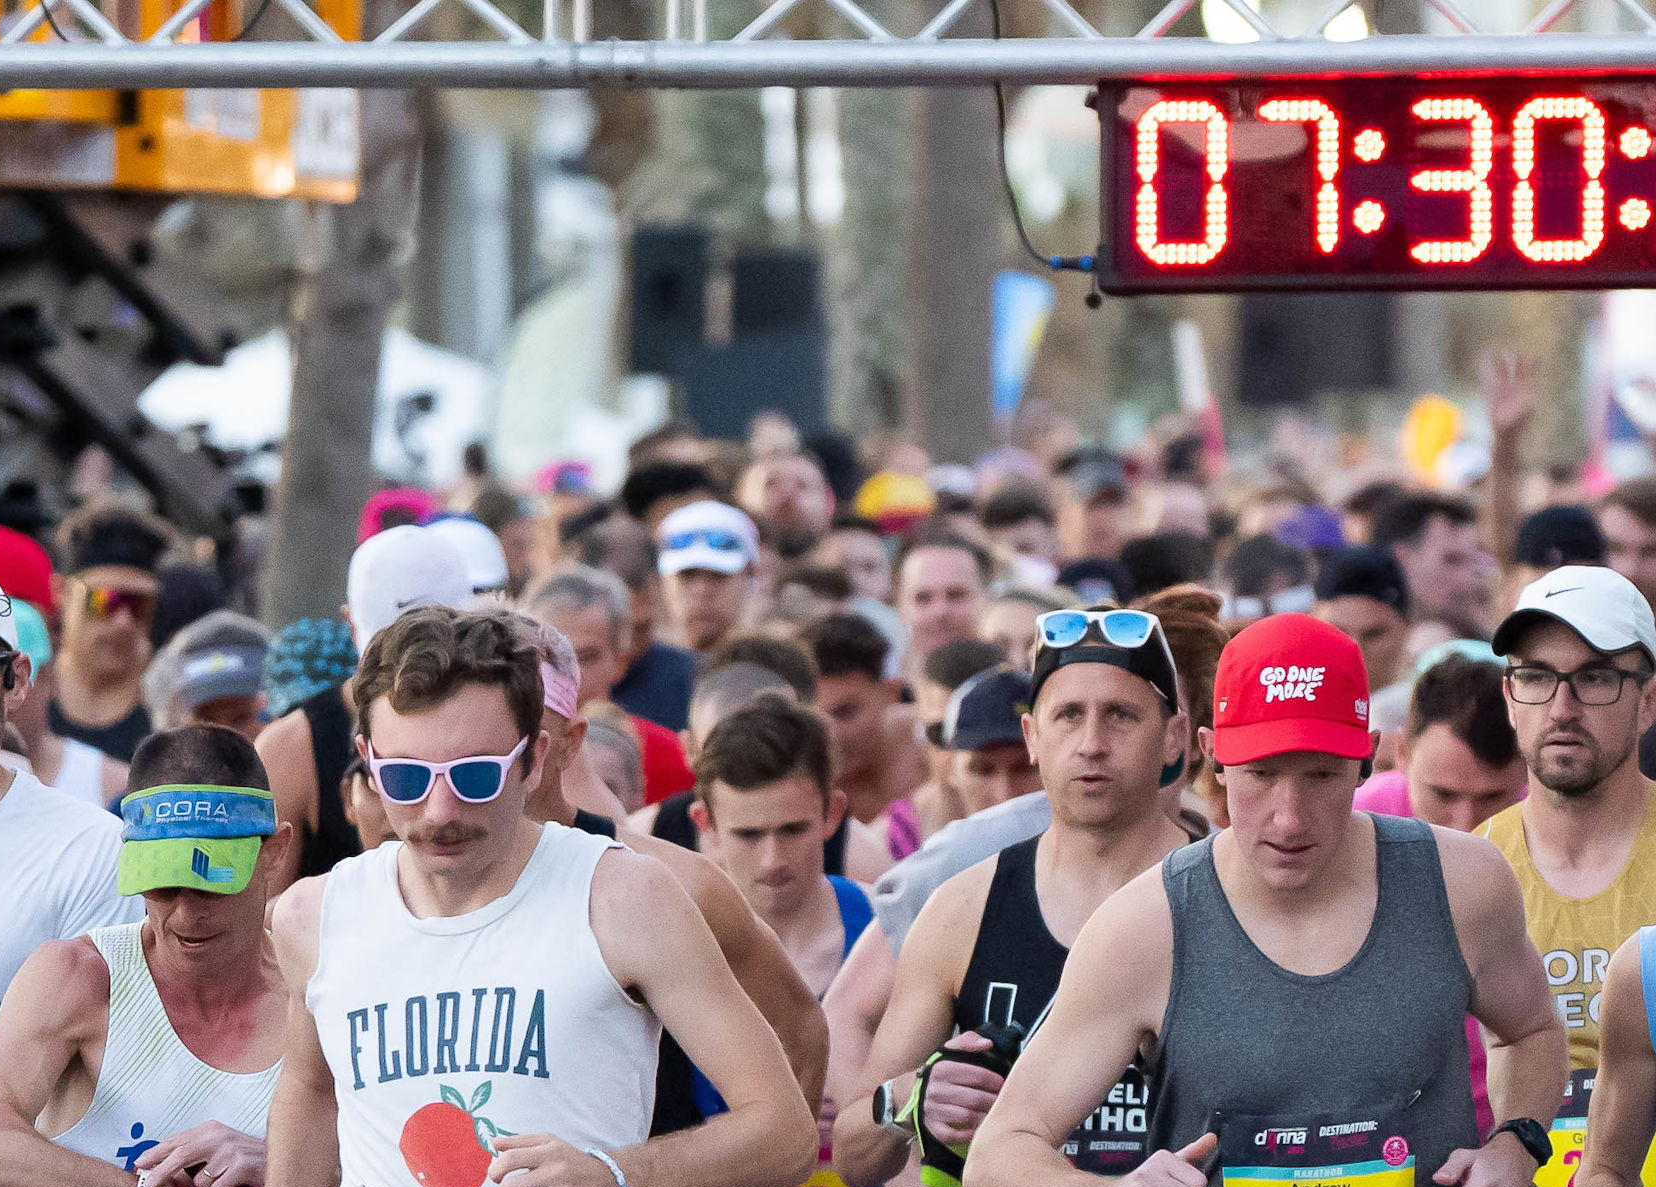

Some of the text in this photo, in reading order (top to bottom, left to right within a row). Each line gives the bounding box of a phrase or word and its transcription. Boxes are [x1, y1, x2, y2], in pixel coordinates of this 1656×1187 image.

[1259, 665, 1326, 685] GO ONE
[1266, 682, 1320, 703] MORE
[156, 801, 229, 817] CORA
[156, 815, 191, 824] Physical
[347, 986, 550, 1091] FLORIDA
[1319, 1120, 1378, 1137] DESTINATION:
